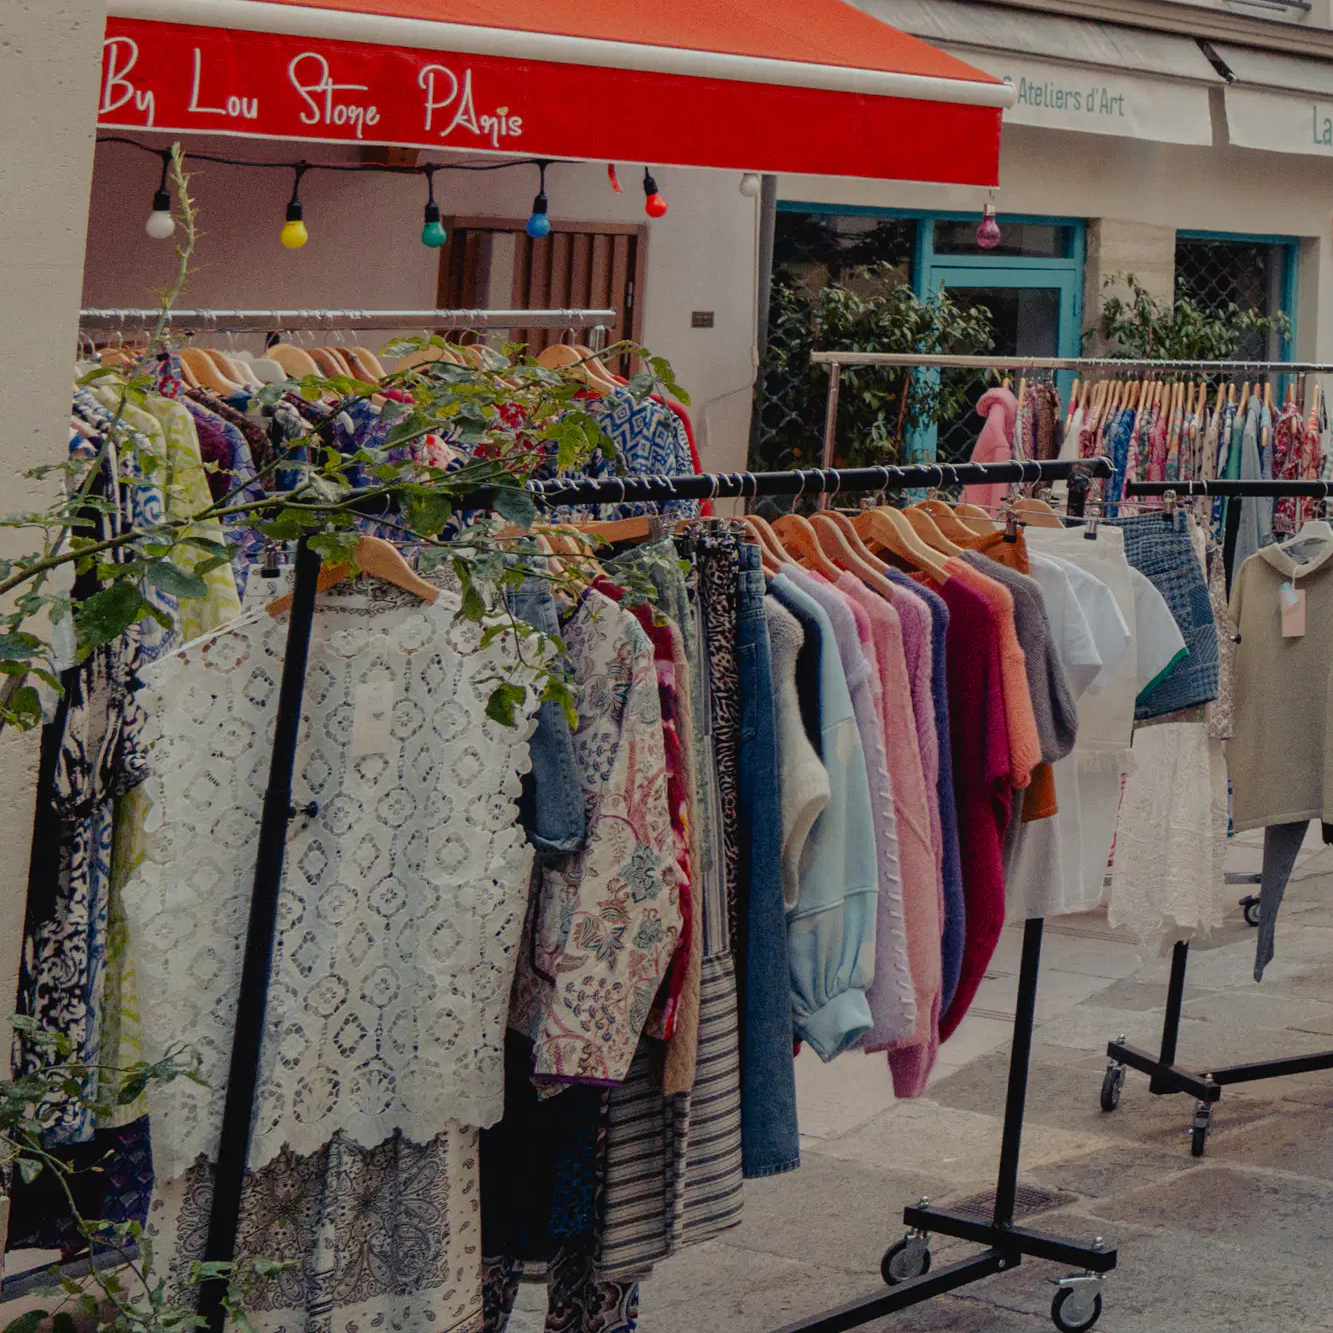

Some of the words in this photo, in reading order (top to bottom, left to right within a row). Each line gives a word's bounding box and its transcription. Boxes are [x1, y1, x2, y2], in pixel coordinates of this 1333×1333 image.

[99, 36, 155, 127] By
[188, 47, 259, 119] Lou
[289, 52, 381, 138] Store
[1017, 77, 1082, 110] Ateliers
[1086, 87, 1125, 116] d'Art
[1312, 105, 1333, 146] La
